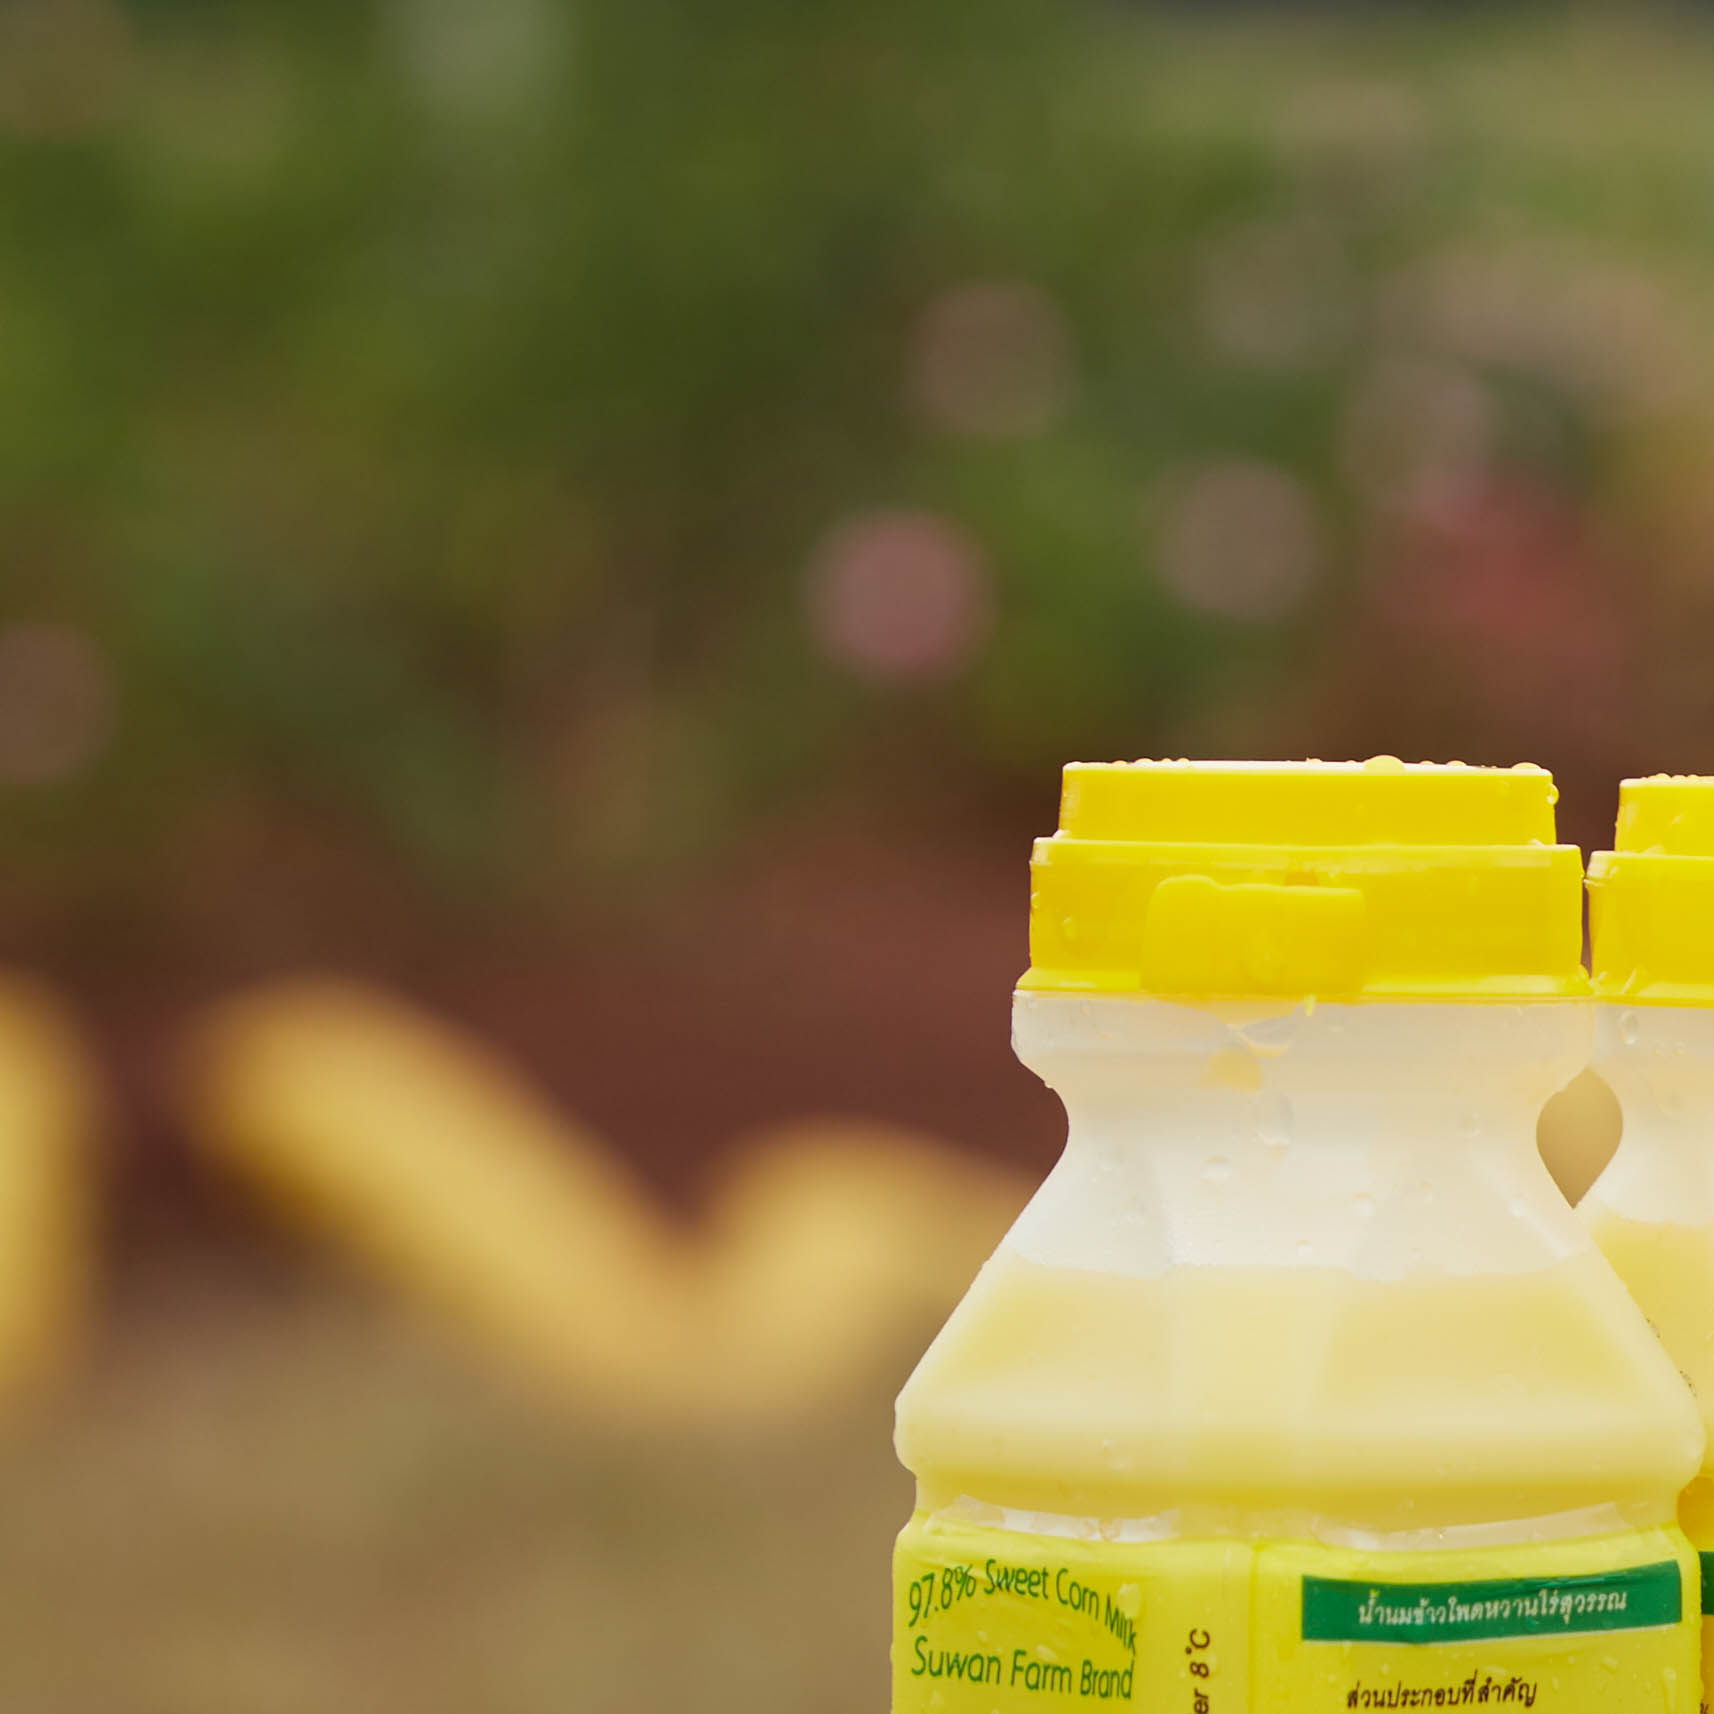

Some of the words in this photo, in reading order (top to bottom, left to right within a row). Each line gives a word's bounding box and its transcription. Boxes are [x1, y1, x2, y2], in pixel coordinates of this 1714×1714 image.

[908, 1564, 977, 1628] 97.8%
[983, 1558, 1049, 1600] Sweet
[1056, 1567, 1100, 1621] Corn
[1105, 1592, 1137, 1657] Milk
[1357, 1587, 1628, 1627] น้ำนมข้าวโพดหวานไร่สุวรรณ
[911, 1634, 1001, 1685] Suwan
[1010, 1648, 1073, 1694] Farm
[1080, 1658, 1136, 1700] Brand
[1345, 1669, 1538, 1709] ส่วนประกอบที่สำคัญ
